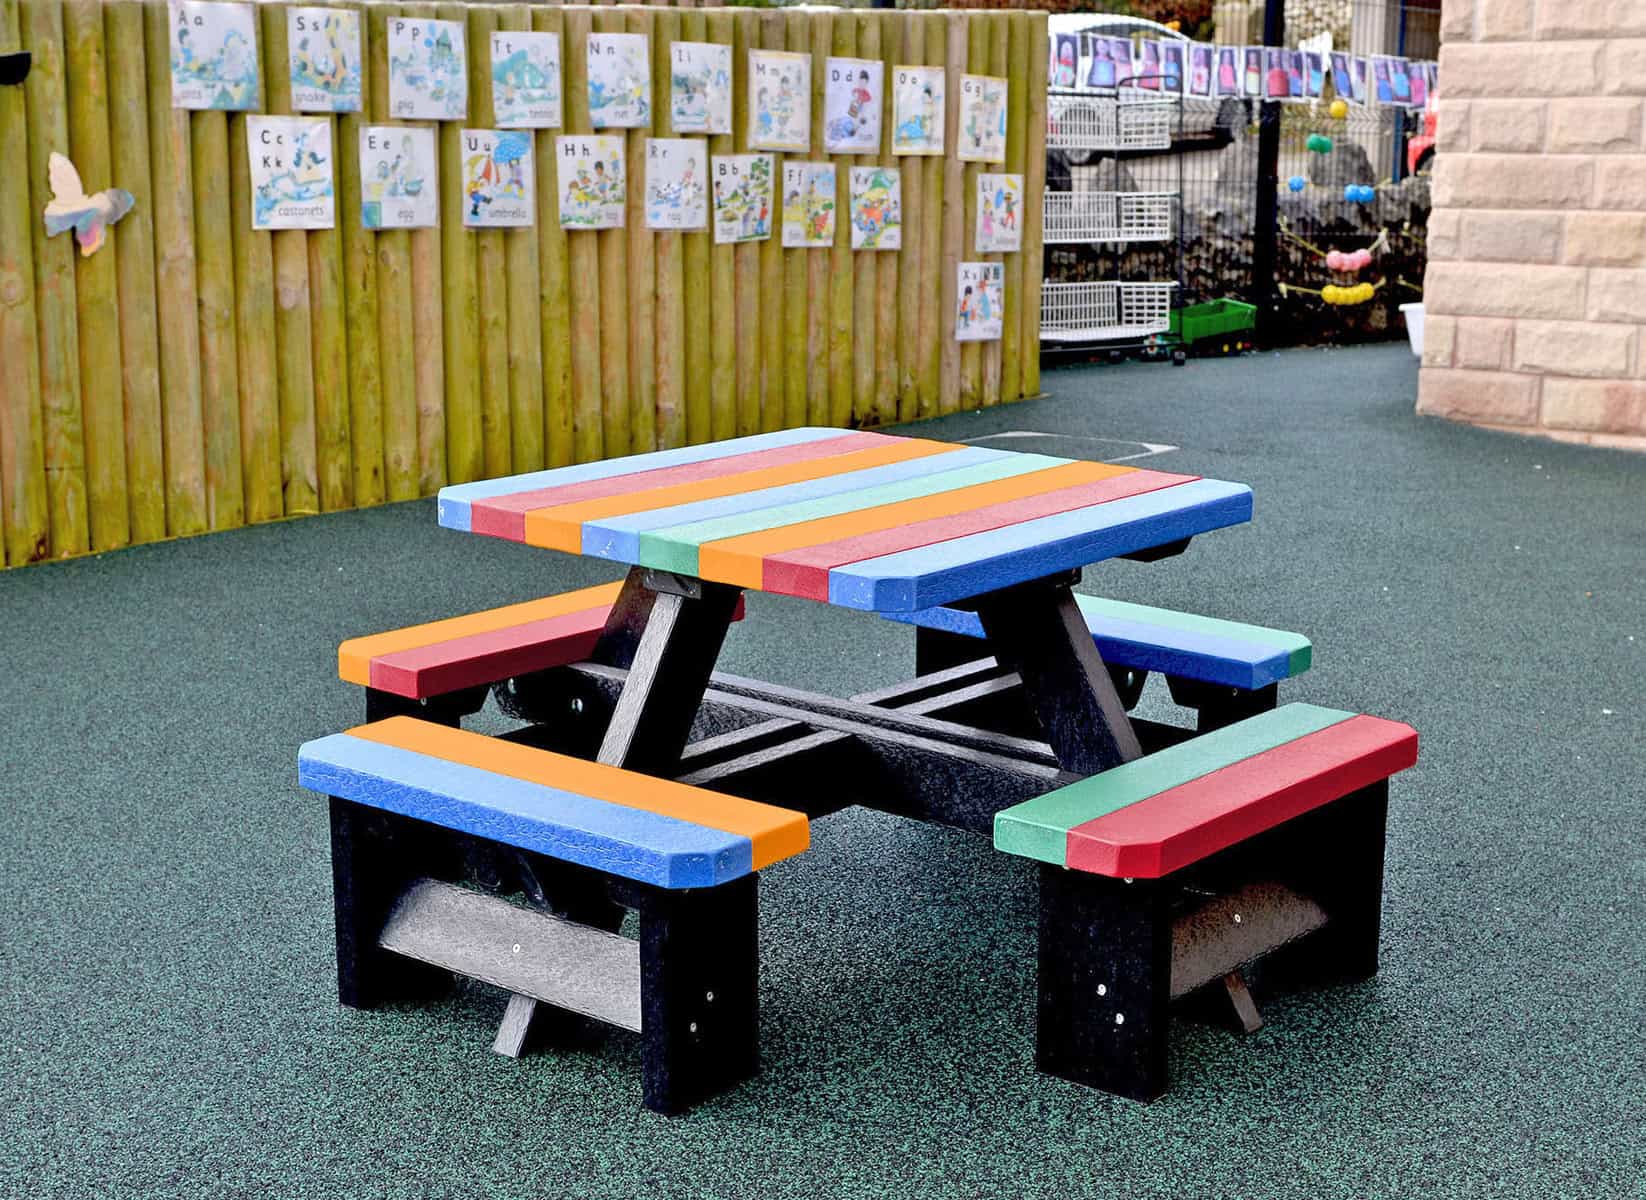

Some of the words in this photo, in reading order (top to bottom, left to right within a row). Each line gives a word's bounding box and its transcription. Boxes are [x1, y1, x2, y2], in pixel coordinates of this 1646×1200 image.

[178, 10, 188, 26] A
[194, 16, 203, 26] a
[296, 16, 305, 31] S
[312, 21, 320, 31] s
[396, 22, 405, 36] P
[412, 27, 420, 40] p
[494, 39, 501, 53] T
[506, 42, 512, 54] t
[589, 41, 600, 55] N
[606, 45, 615, 55] n
[832, 69, 840, 82] D
[846, 71, 853, 82] d
[900, 73, 906, 84] O
[965, 81, 972, 92] G
[261, 129, 271, 144] C
[276, 135, 283, 144] c
[368, 135, 377, 149] E
[383, 140, 391, 150] e
[468, 137, 478, 151] U
[484, 143, 491, 151] u
[565, 144, 575, 156] H
[582, 144, 591, 156] h
[263, 156, 271, 168] K
[275, 157, 282, 168] k
[719, 163, 727, 175] B
[732, 163, 738, 175] b
[963, 270, 970, 280] X
